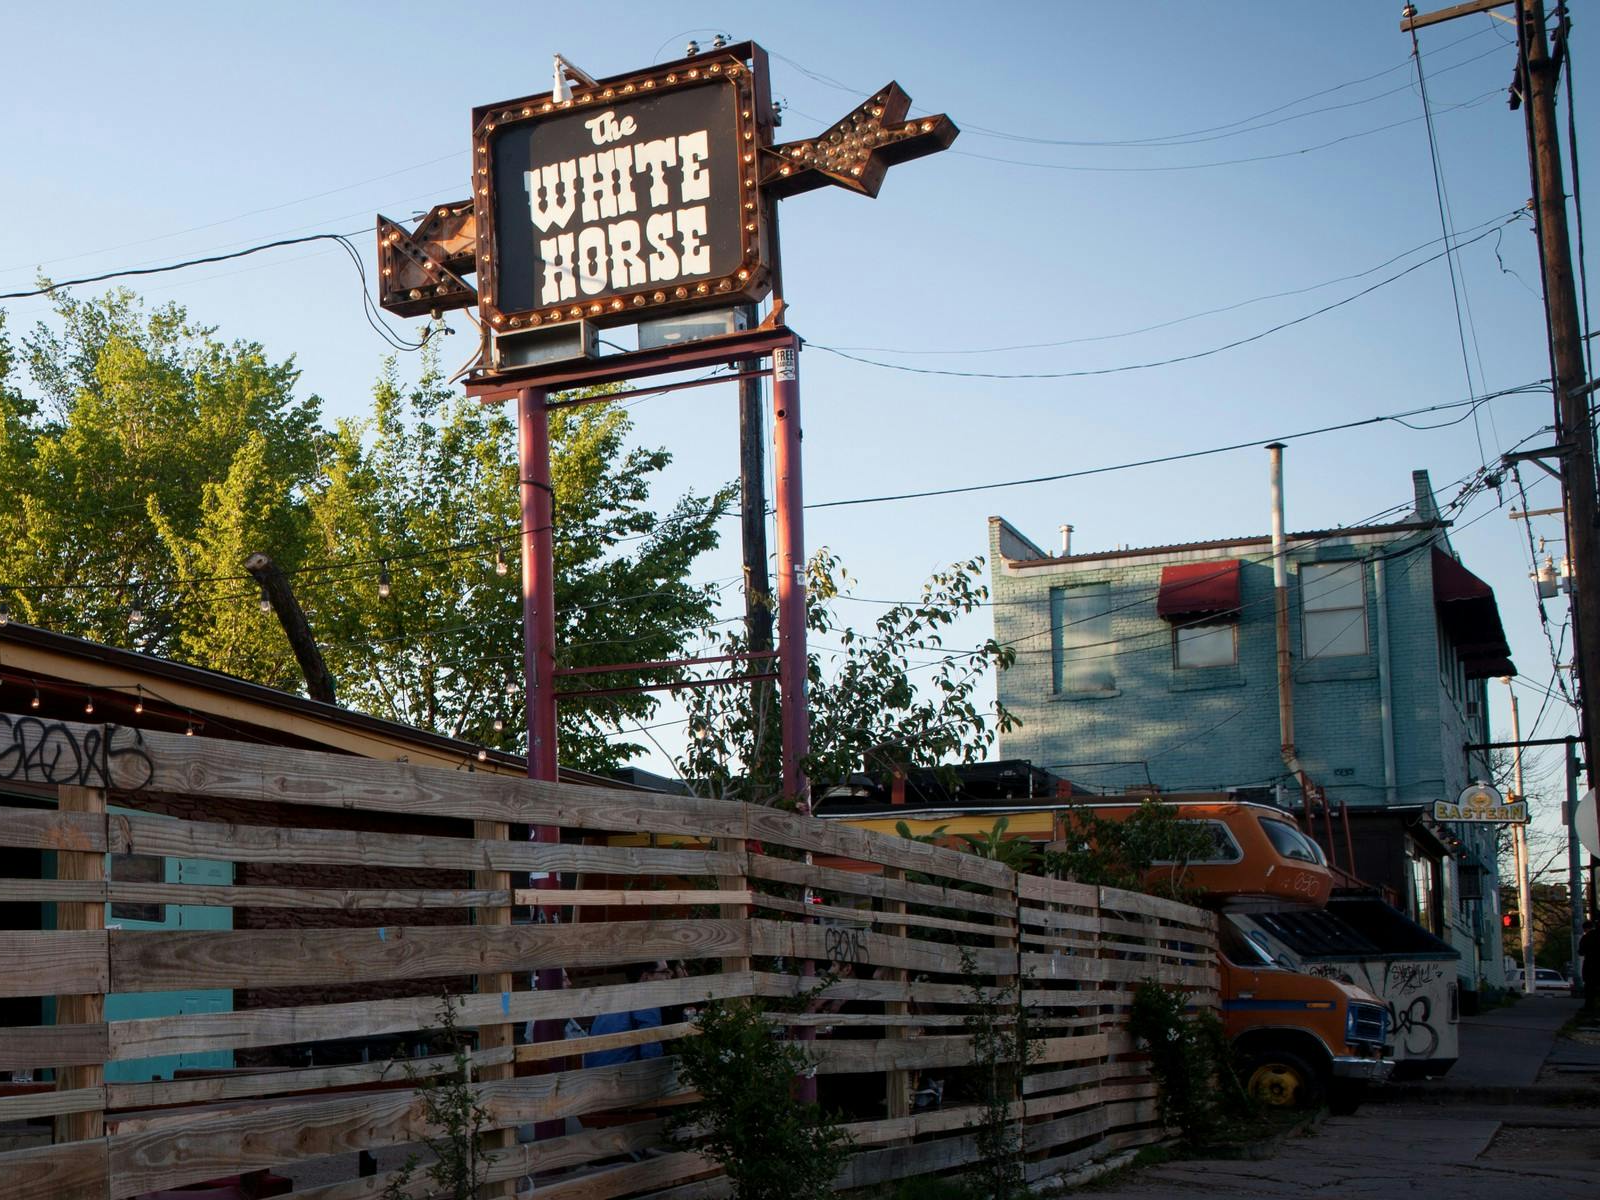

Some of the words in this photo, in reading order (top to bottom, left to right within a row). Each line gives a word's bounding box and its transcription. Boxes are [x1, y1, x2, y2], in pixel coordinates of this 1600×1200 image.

[585, 111, 637, 145] The
[524, 130, 710, 233] WHITE
[540, 206, 710, 305] HORSE
[776, 350, 794, 361] FREE
[1436, 803, 1524, 819] EASTERN
